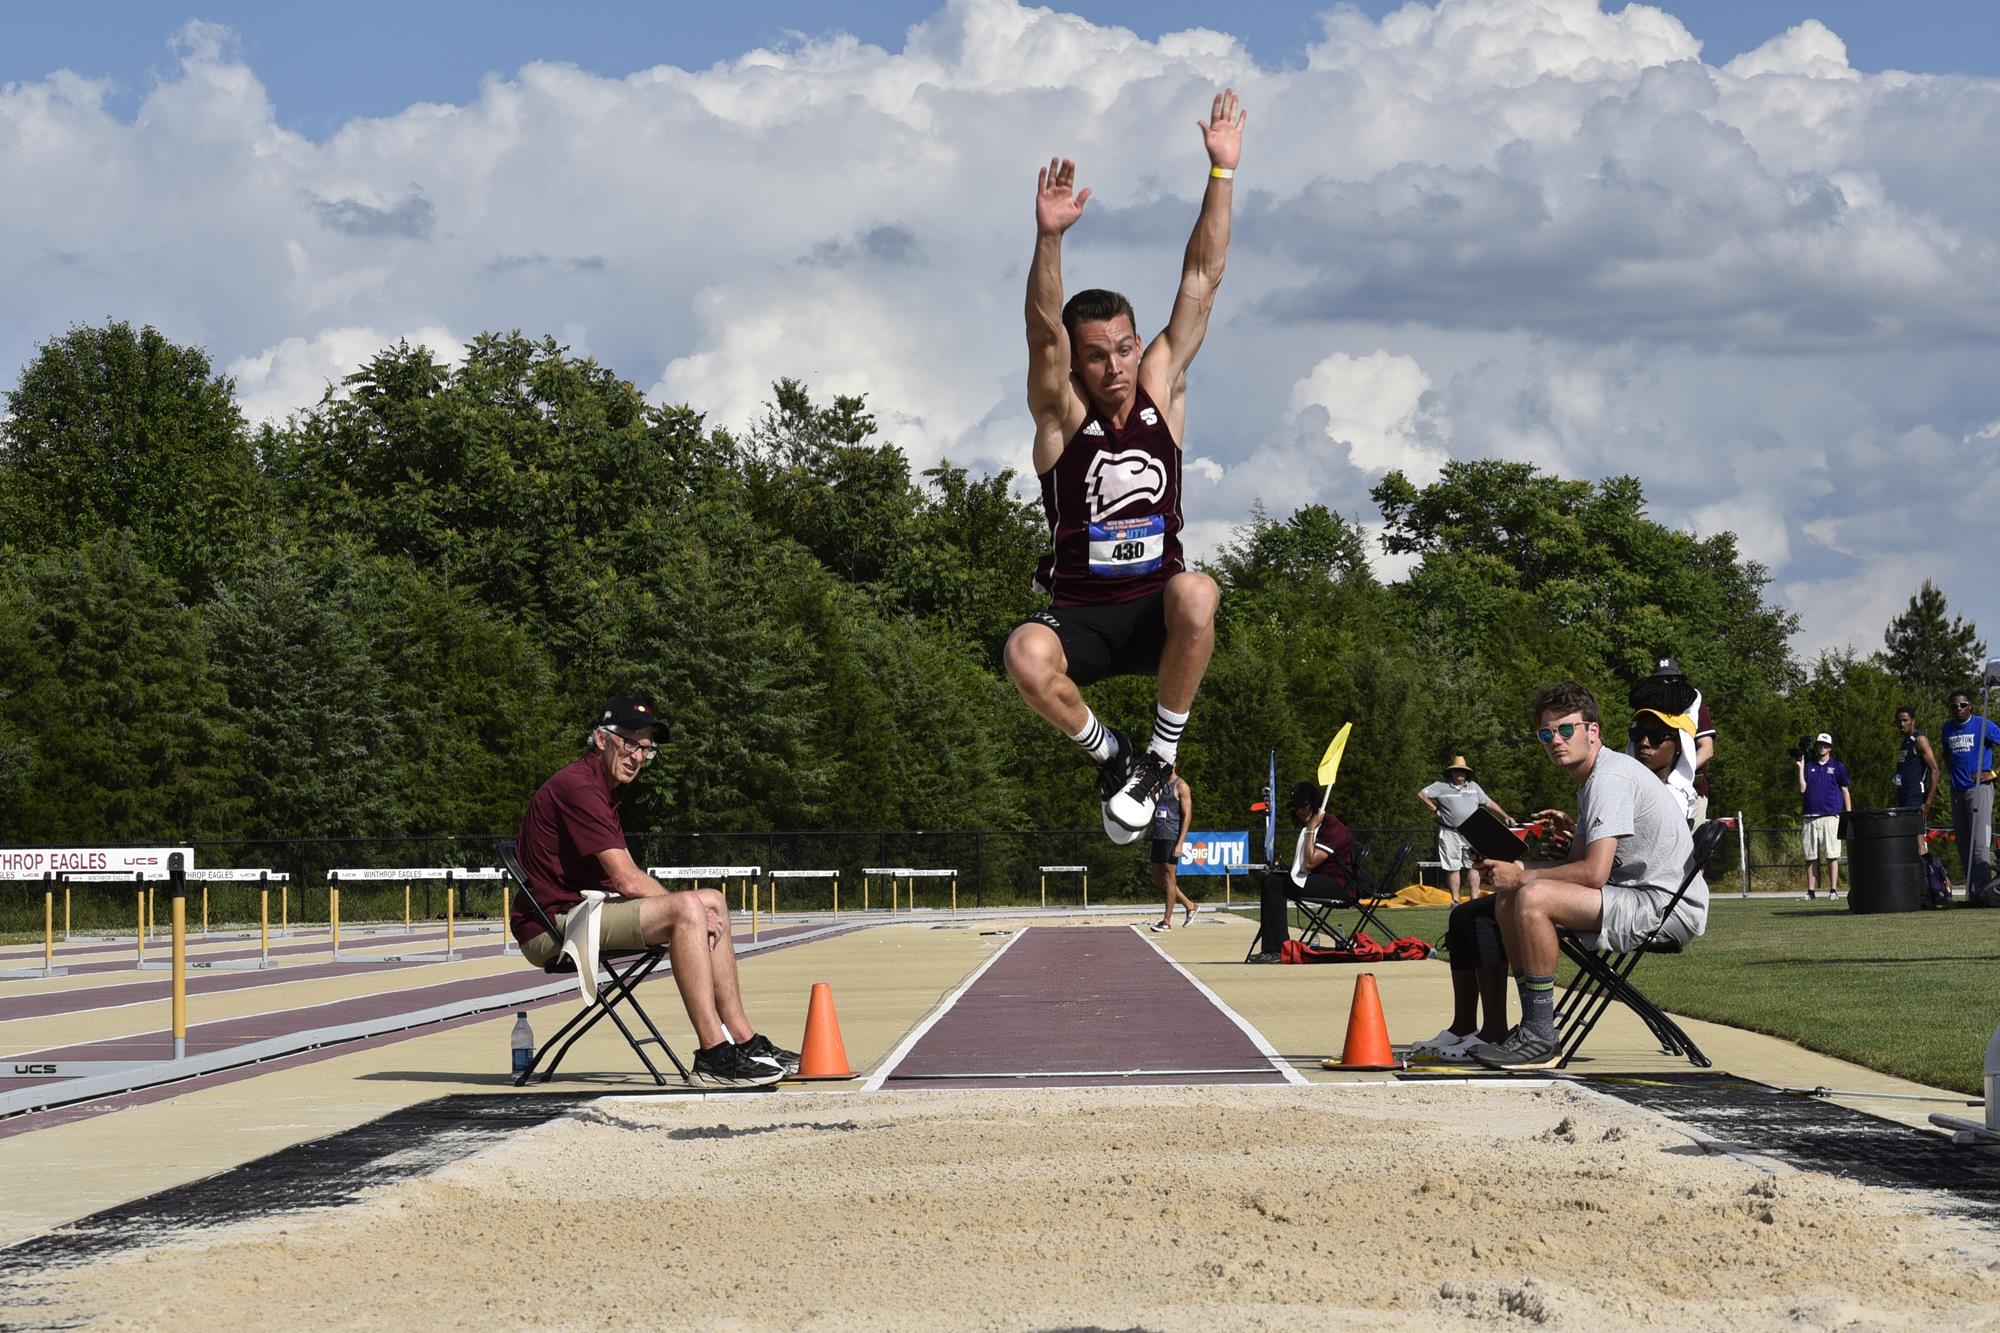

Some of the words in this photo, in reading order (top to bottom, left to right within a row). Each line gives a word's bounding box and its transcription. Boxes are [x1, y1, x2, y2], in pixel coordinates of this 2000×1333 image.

[1083, 428, 1104, 436] adidas
[1112, 541, 1145, 561] 430
[51, 853, 107, 870] EAGLES
[124, 858, 159, 866] UCS
[208, 870, 234, 880] EAGLES
[363, 870, 396, 879] WINTHROP
[398, 870, 422, 878] EAGLES
[678, 868, 707, 877] WINTHROP
[708, 868, 730, 876] EAGLES
[15, 1064, 57, 1074] UCS
